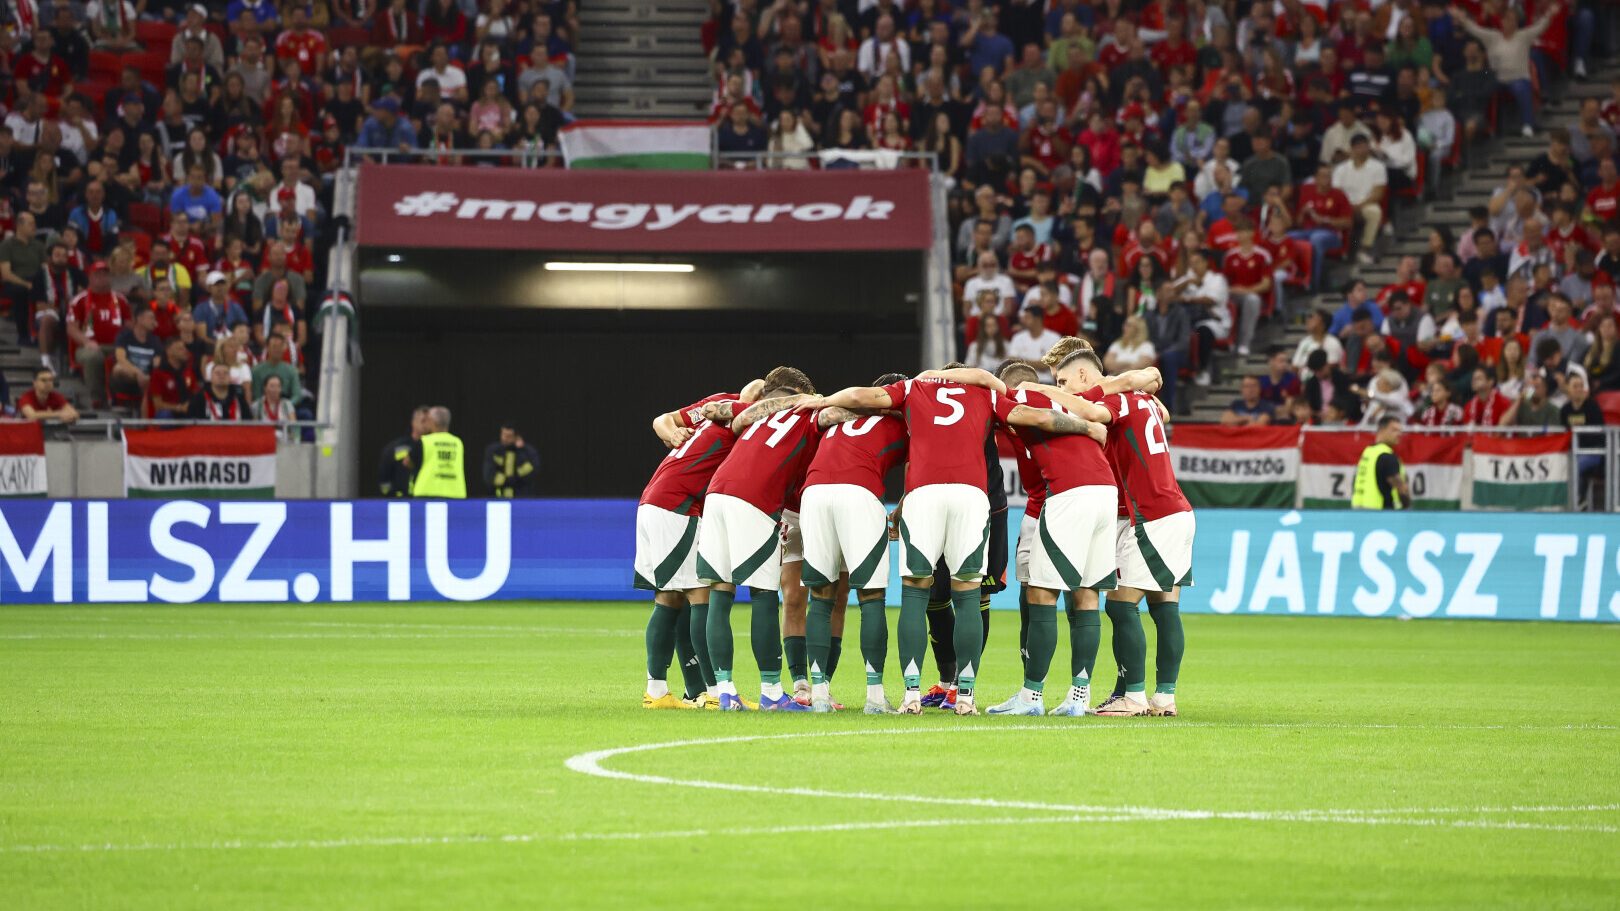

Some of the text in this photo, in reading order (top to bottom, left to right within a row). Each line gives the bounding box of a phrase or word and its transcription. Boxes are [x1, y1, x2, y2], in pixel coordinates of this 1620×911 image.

[394, 191, 895, 231] #magyarok
[933, 387, 966, 426] 5
[1489, 458, 1550, 480] TASS
[0, 500, 512, 603] MLSZ.HU
[1209, 510, 1620, 620] JÁTSSZ TI
